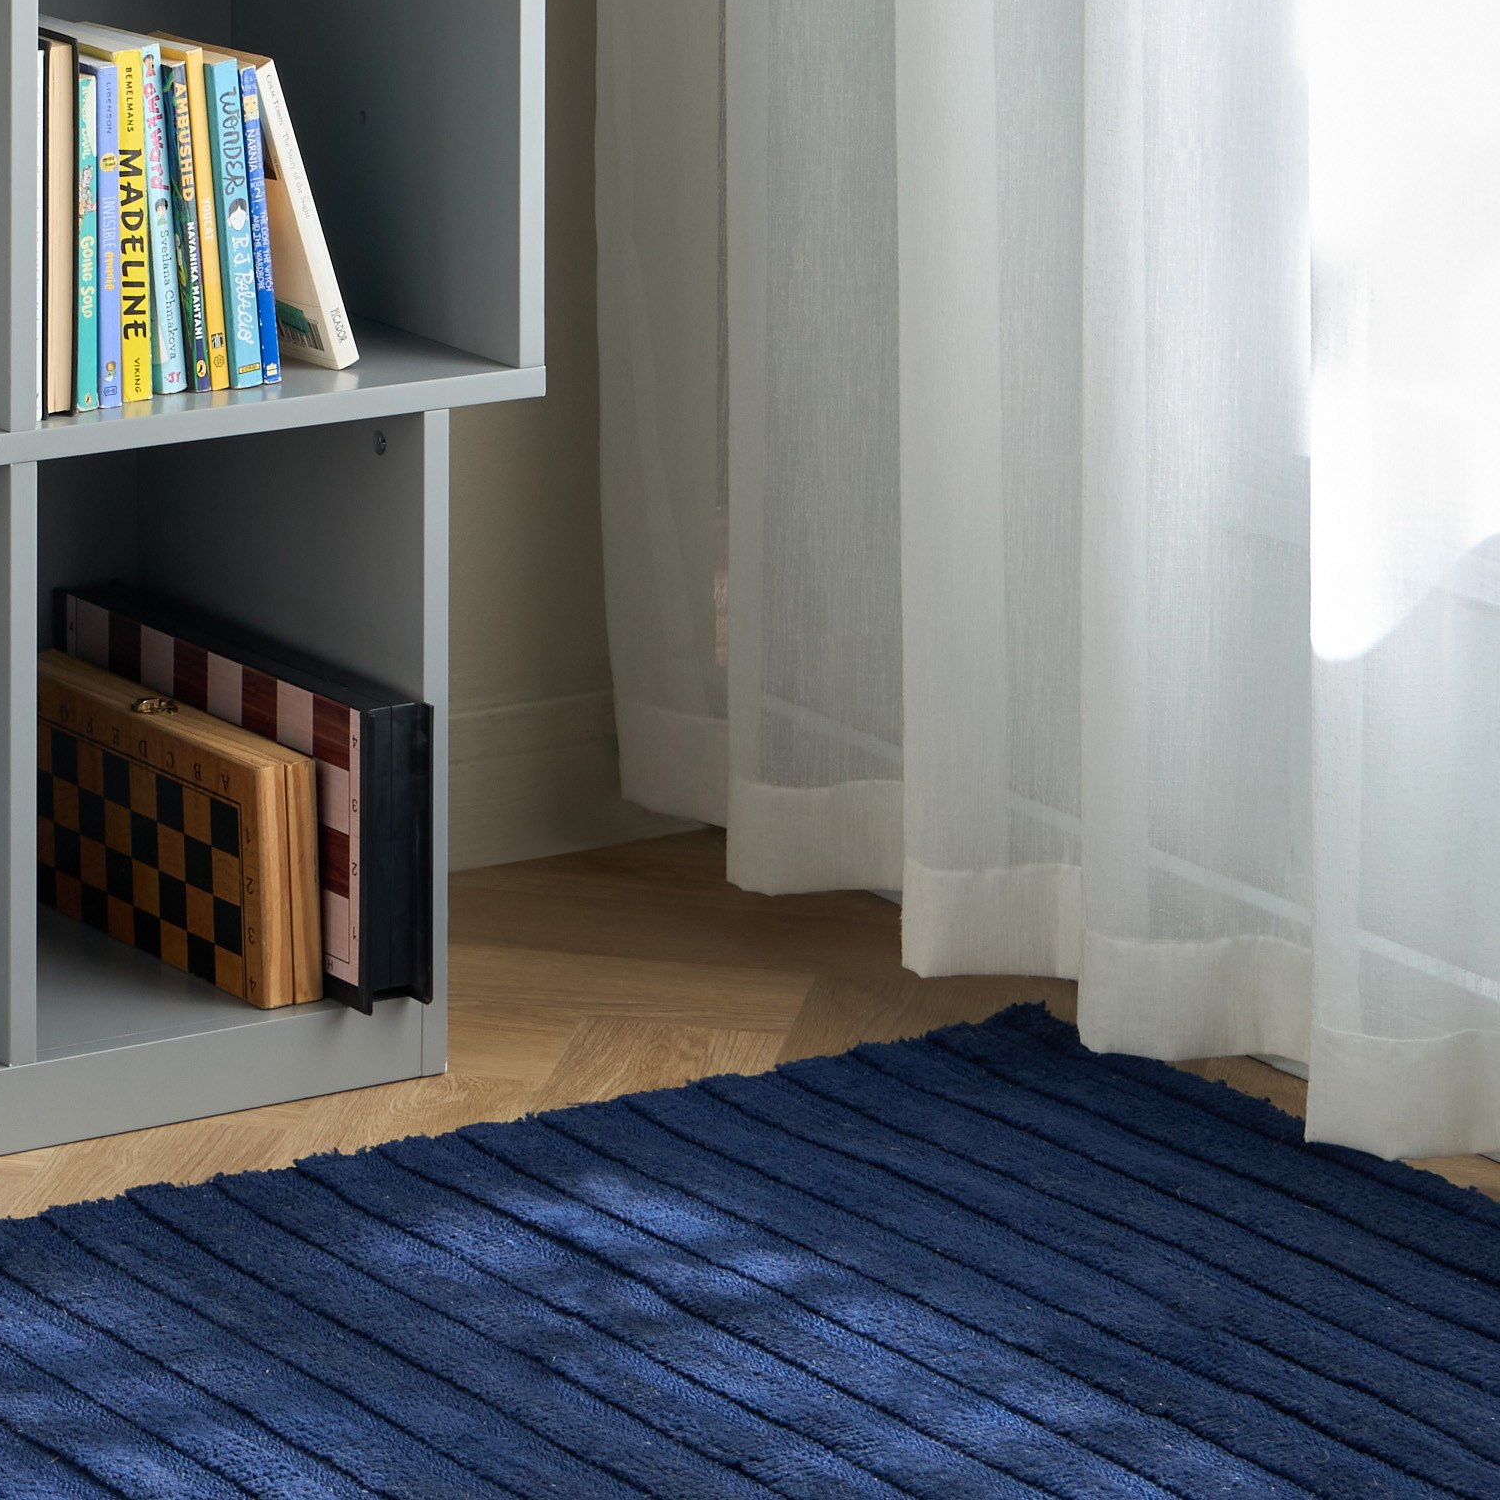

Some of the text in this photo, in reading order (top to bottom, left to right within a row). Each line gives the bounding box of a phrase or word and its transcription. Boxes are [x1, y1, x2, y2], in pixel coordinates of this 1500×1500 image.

[125, 67, 135, 133] BEMELMANS
[143, 83, 170, 191] awkward
[174, 82, 195, 202] AMBUSHED
[266, 74, 276, 99] COLM
[282, 133, 290, 147] The
[286, 148, 295, 170] Story
[293, 171, 299, 181] of
[299, 196, 311, 219] Night
[246, 128, 256, 173] NARNIA
[254, 187, 261, 198] 2
[201, 196, 214, 241] YOUCAT
[102, 196, 117, 292] INVISIBLE emmie
[118, 149, 148, 340] MADELINE
[231, 232, 250, 252] R.
[254, 232, 262, 248] THE
[233, 254, 251, 268] J.
[255, 249, 266, 290] WARDROBE
[80, 235, 95, 319] GOING SOLO
[187, 222, 203, 341] NAYANIKA MAHTANI
[264, 265, 272, 292] WITCH
[160, 230, 179, 360] Svetlana Chmakova
[330, 307, 348, 344] PICADOR
[134, 357, 142, 394] VIKING
[139, 740, 147, 757] D
[352, 734, 358, 749] 4
[165, 751, 175, 768] C
[193, 763, 202, 781] B
[220, 773, 231, 791] A
[352, 799, 358, 812] 3
[245, 828, 251, 844] 1
[352, 862, 358, 876] 2
[245, 877, 254, 894] 2
[247, 927, 255, 945] 3
[352, 926, 356, 939] 1
[248, 978, 257, 994] 4
